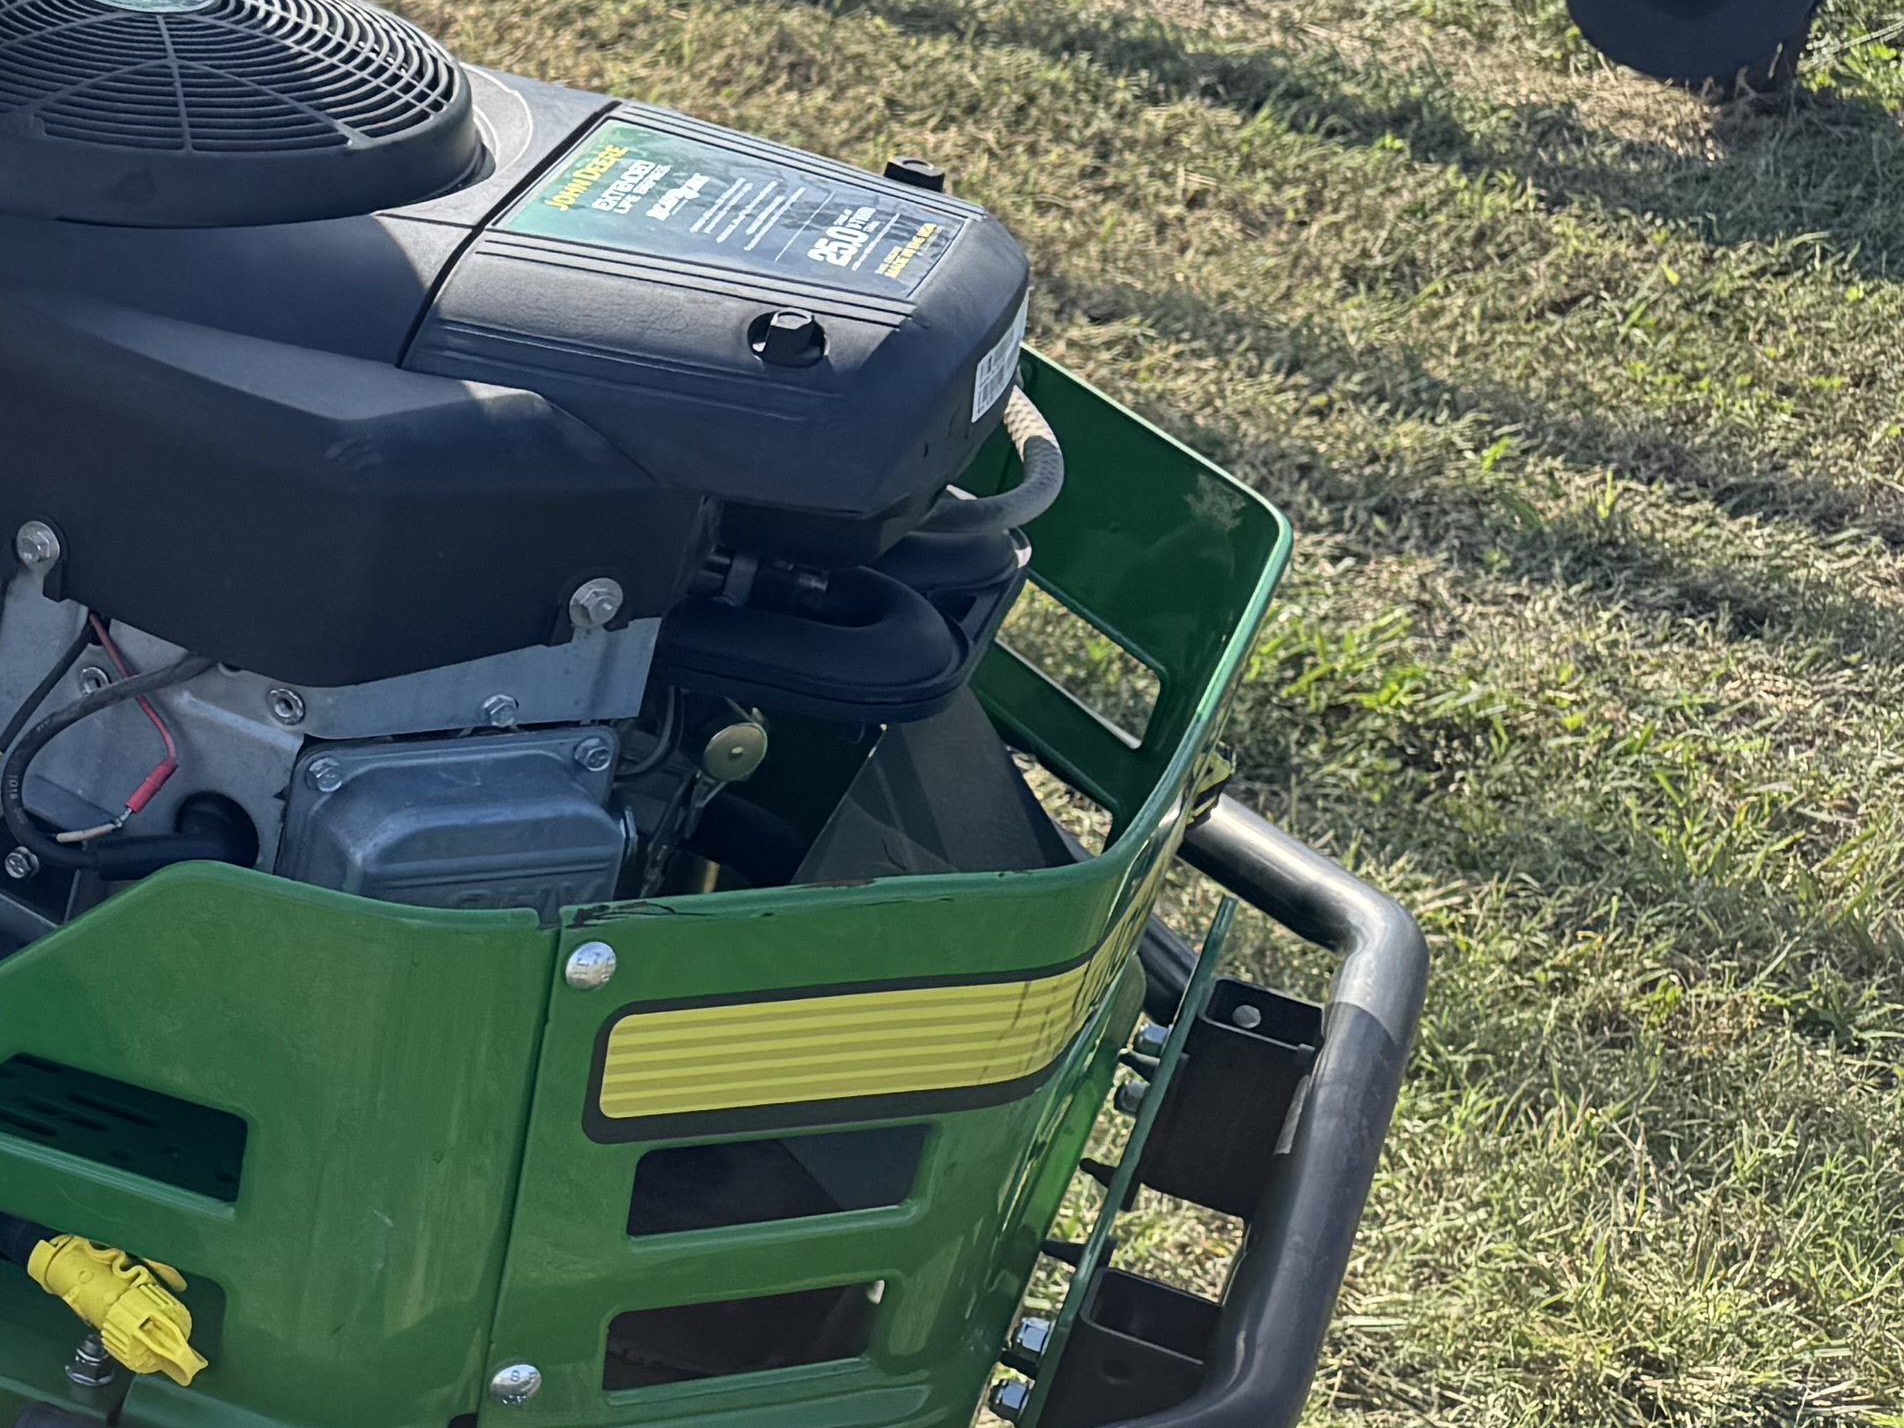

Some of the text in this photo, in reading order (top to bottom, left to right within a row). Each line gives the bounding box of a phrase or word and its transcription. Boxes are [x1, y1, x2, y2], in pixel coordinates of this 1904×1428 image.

[544, 144, 630, 212] JOHN DEERE
[592, 159, 656, 211] EXTENDED
